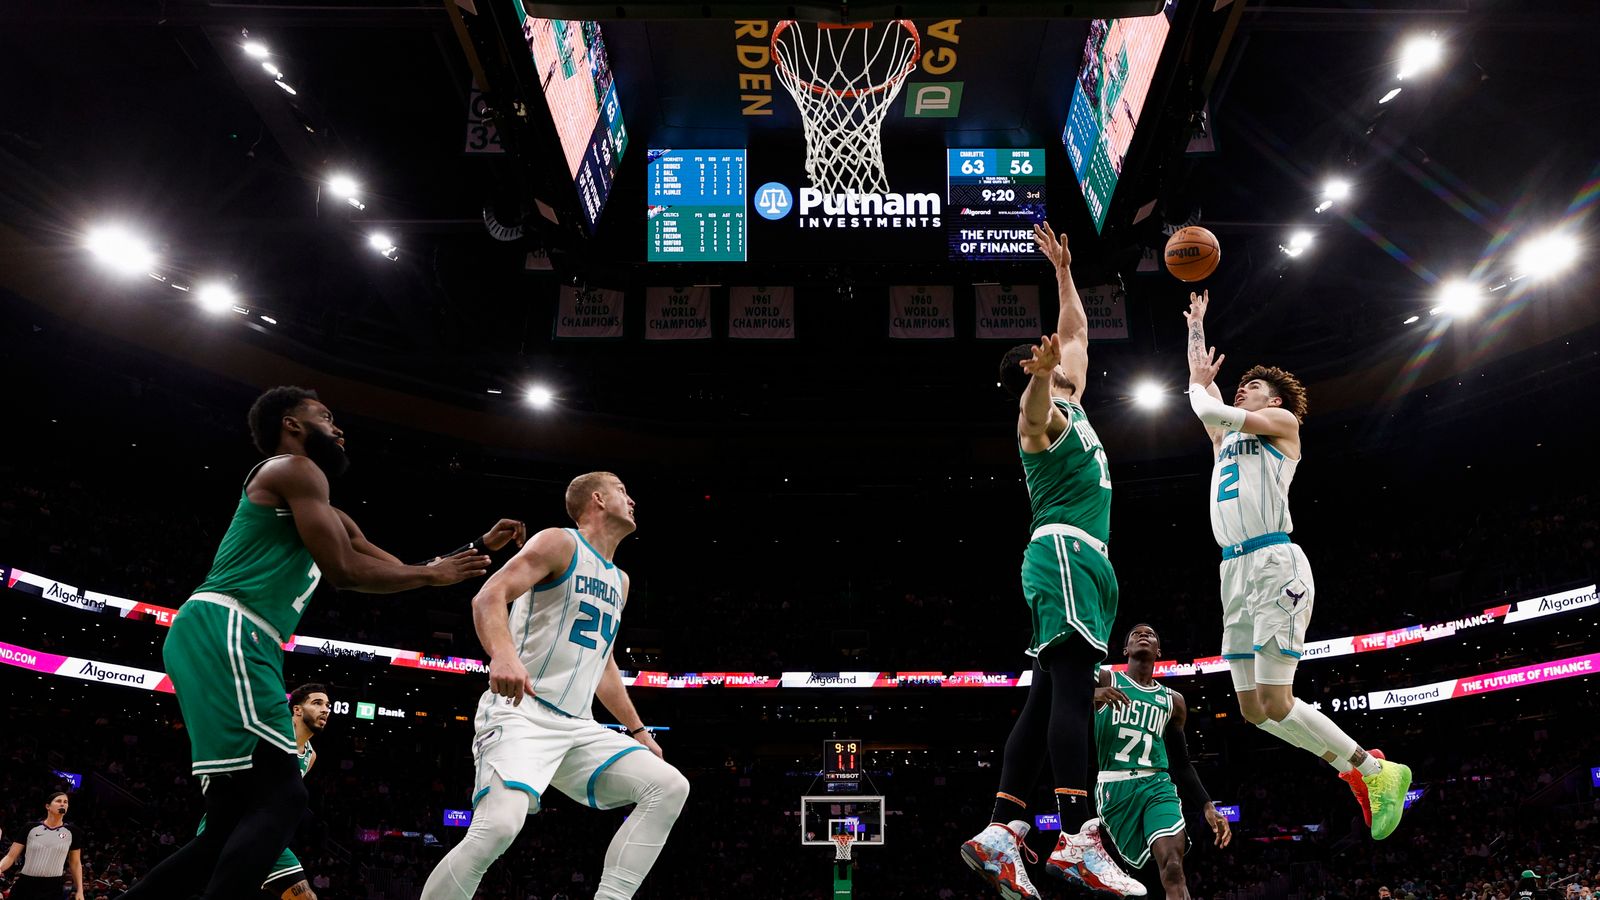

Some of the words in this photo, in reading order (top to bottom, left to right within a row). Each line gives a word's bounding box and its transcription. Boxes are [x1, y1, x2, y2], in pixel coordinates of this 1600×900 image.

[961, 159, 985, 175] 63
[1010, 159, 1033, 175] 56
[982, 189, 1015, 201] 9:20
[1026, 191, 1040, 199] 3rd
[800, 187, 941, 216] Putnam
[960, 207, 991, 216] Algorand
[800, 218, 941, 228] INVESTMENTS
[960, 230, 984, 240] THE
[987, 230, 1034, 240] FUTURE
[960, 243, 977, 253] OF
[980, 243, 1034, 253] FINANCE
[583, 294, 604, 304] 963
[575, 305, 609, 316] WORLD
[661, 307, 696, 317] WORLD
[745, 306, 779, 316] WORLD
[904, 307, 938, 317] WORLD
[991, 307, 1026, 317] WORLD
[1087, 307, 1112, 317] ORLD
[561, 316, 619, 328] CHAMPIONS
[649, 317, 707, 329] CHAMPIONS
[733, 318, 790, 329] CHAMPIONS
[893, 317, 950, 329] CHAMPIONS
[980, 317, 1037, 329] CHAMPIONS
[1088, 318, 1124, 328] MPIONS
[1217, 463, 1239, 502] 2
[1538, 592, 1599, 612] Algorand
[568, 600, 620, 659] 24
[1361, 637, 1385, 648] THE
[1300, 644, 1330, 656] orand
[79, 662, 144, 684] Algorand
[1462, 682, 1482, 692] THE
[1484, 672, 1526, 688] FUTURE
[1527, 669, 1542, 680] OF
[1543, 660, 1592, 677] FINANCE
[647, 675, 667, 684] THE
[726, 675, 769, 684] FINANCE
[1384, 688, 1439, 705] Algorand
[1331, 695, 1367, 712] 9:03
[358, 704, 375, 718] TD
[378, 706, 405, 718] Bank
[835, 743, 856, 753] 9:19
[1114, 726, 1153, 767] 71
